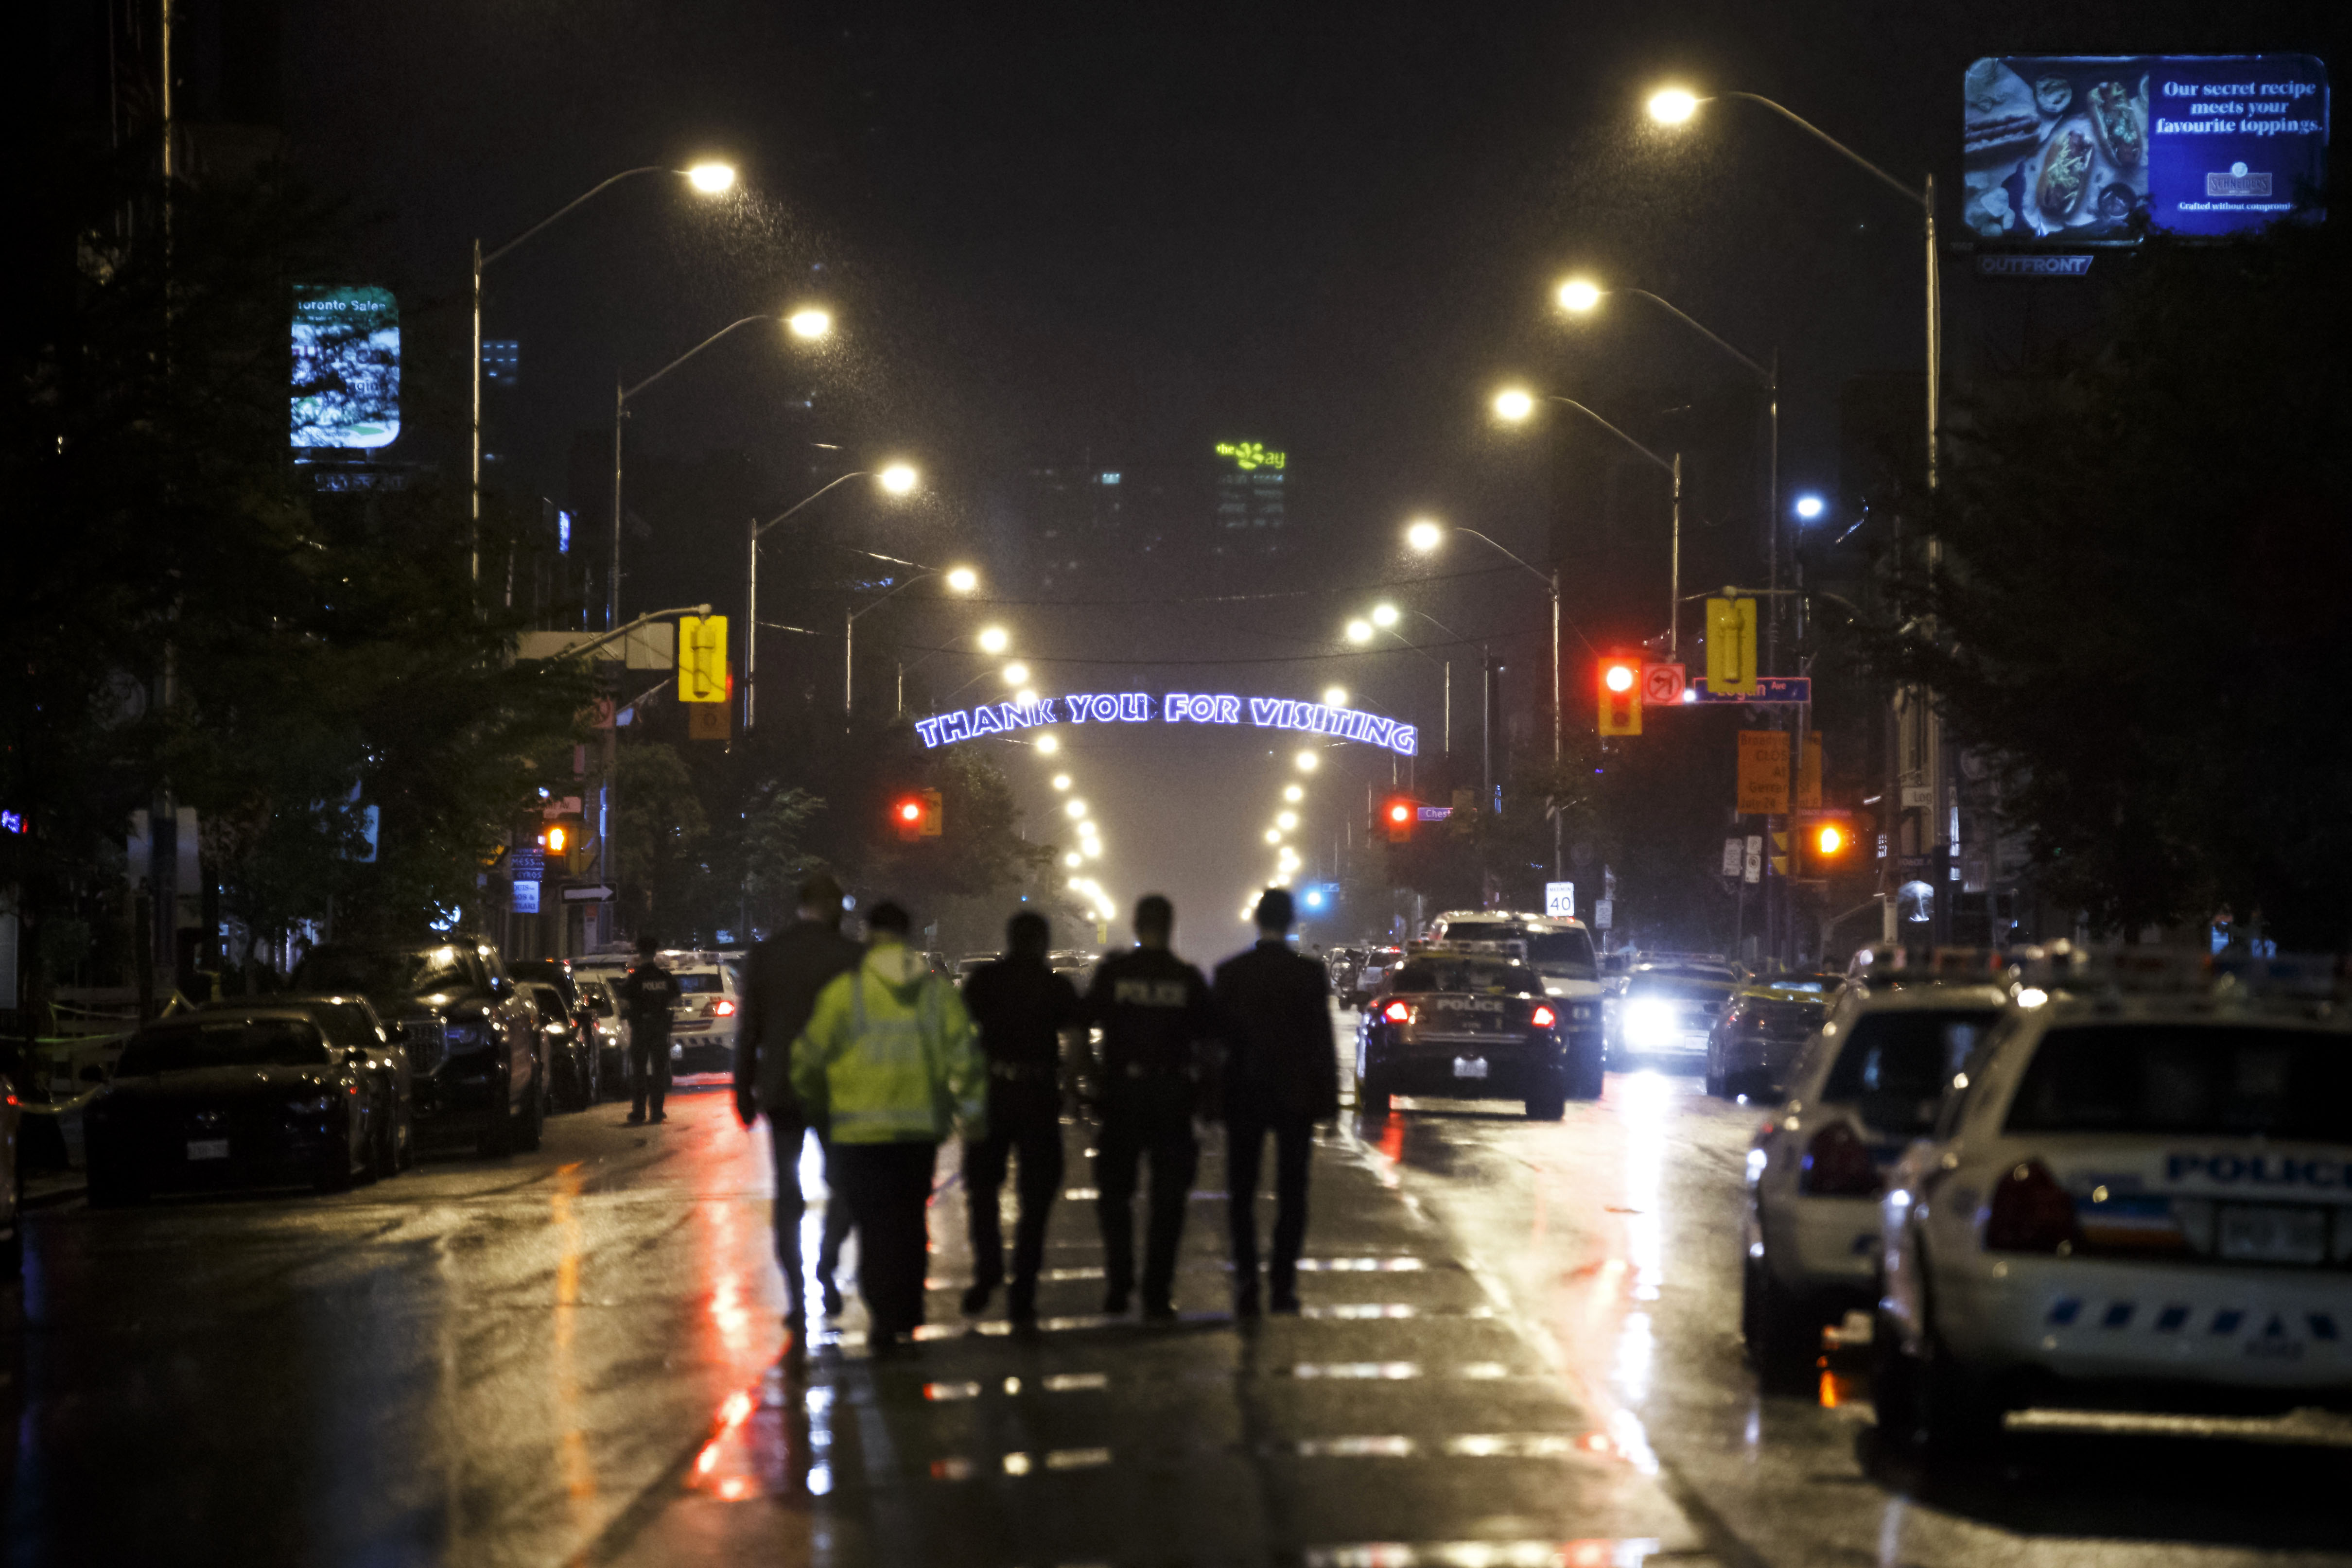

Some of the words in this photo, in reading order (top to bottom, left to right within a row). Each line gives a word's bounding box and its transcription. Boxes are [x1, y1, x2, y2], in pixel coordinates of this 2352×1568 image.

[2164, 81, 2199, 96] Our
[2203, 82, 2256, 96] secret
[2261, 80, 2316, 99] recipe
[2191, 101, 2244, 114] meets
[2248, 102, 2289, 117] your
[2157, 118, 2236, 133] favourite
[2240, 118, 2323, 136] toppings.
[2179, 202, 2211, 210] Crafted
[2212, 202, 2244, 210] without
[2246, 202, 2297, 212] compromi
[1983, 258, 2086, 272] OUTFRONT
[1217, 443, 1235, 454] the
[1771, 680, 1787, 690] Ave
[916, 698, 1057, 748] THANK
[1066, 693, 1148, 723] YOU
[1165, 694, 1240, 723] FOR
[1250, 698, 1415, 755] VISITING
[1757, 751, 1788, 761] CLOS
[1426, 809, 1451, 818] Chest
[1550, 897, 1571, 910] 40
[642, 980, 668, 991] POLICE
[1437, 999, 1505, 1014] POLICE
